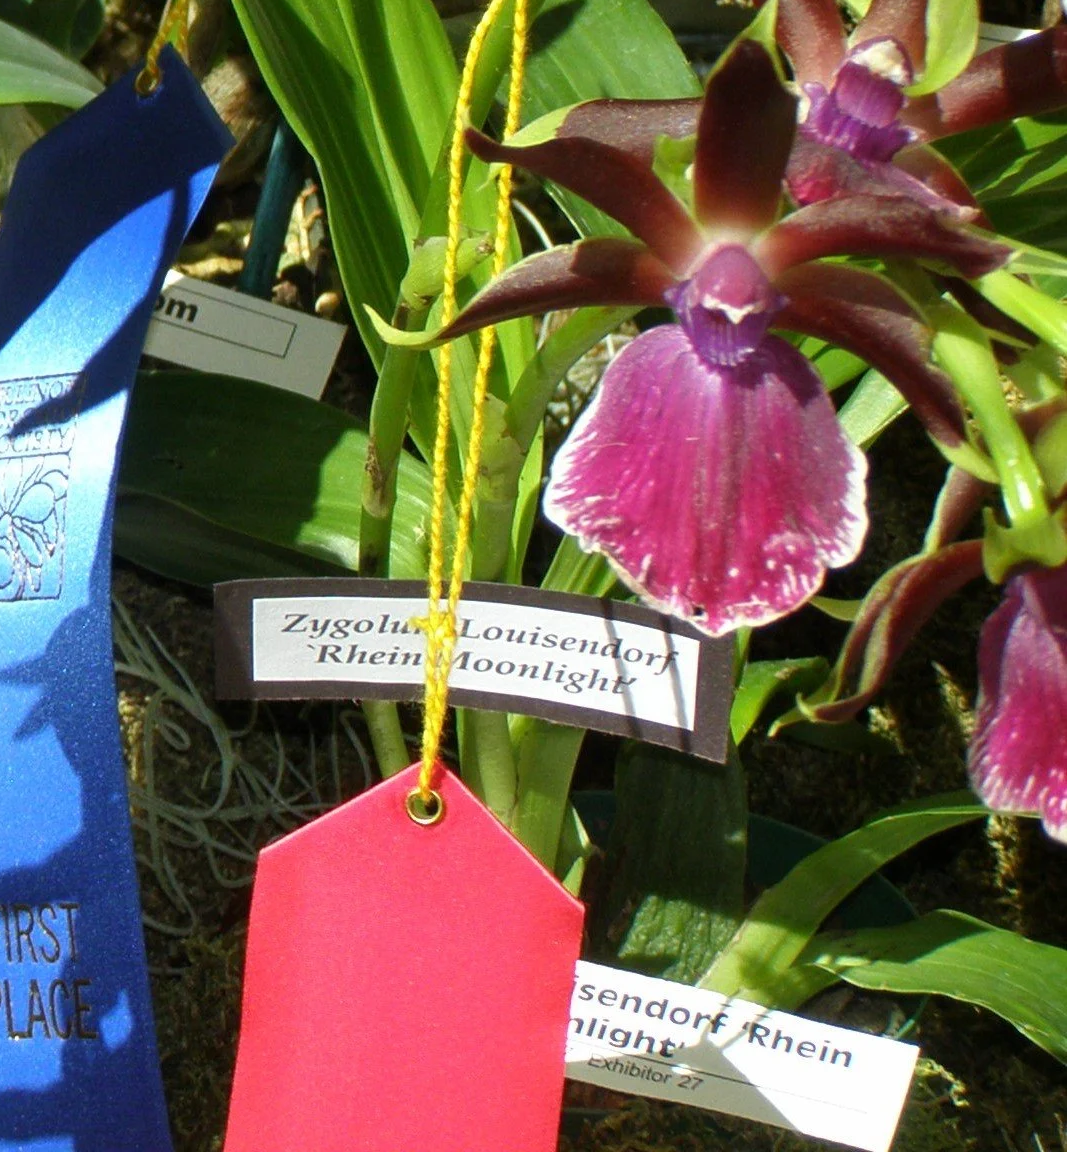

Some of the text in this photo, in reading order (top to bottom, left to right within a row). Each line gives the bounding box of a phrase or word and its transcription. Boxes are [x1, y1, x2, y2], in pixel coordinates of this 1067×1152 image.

[281, 613, 680, 676] Zygolu Louisendorf
[587, 1052, 704, 1091] Exhibitor 27
